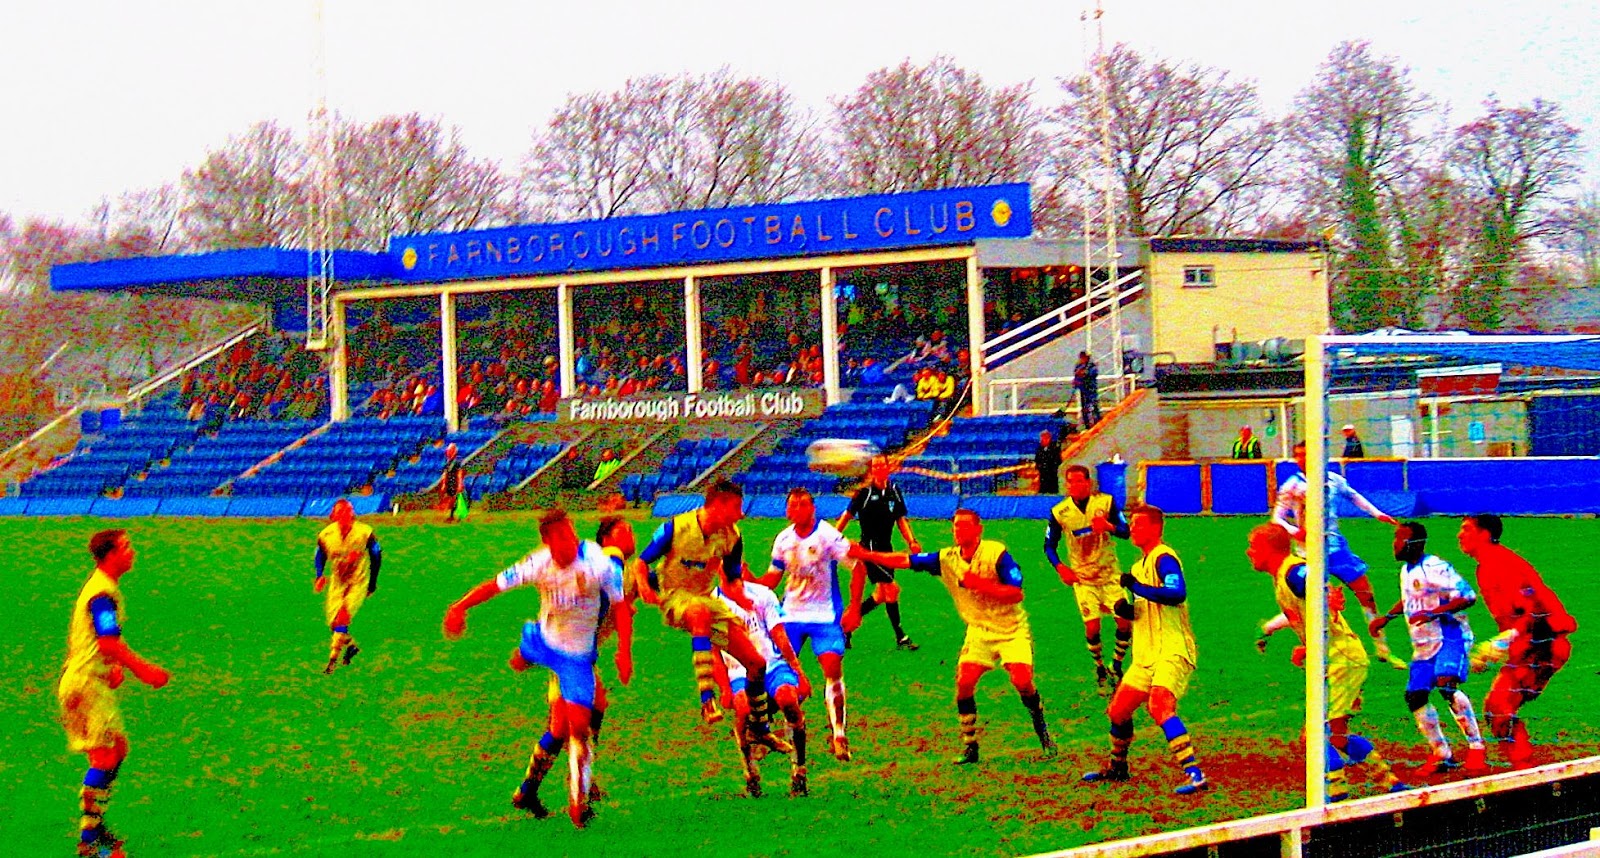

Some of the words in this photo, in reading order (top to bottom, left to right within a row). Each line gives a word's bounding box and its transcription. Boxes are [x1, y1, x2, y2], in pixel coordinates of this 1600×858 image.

[428, 224, 660, 269] FARNBOROUGH
[672, 210, 858, 250] FOOTBALL
[875, 200, 975, 237] CLUB
[570, 397, 679, 421] Farnborough
[685, 393, 755, 418] Football
[761, 391, 804, 415] Club
